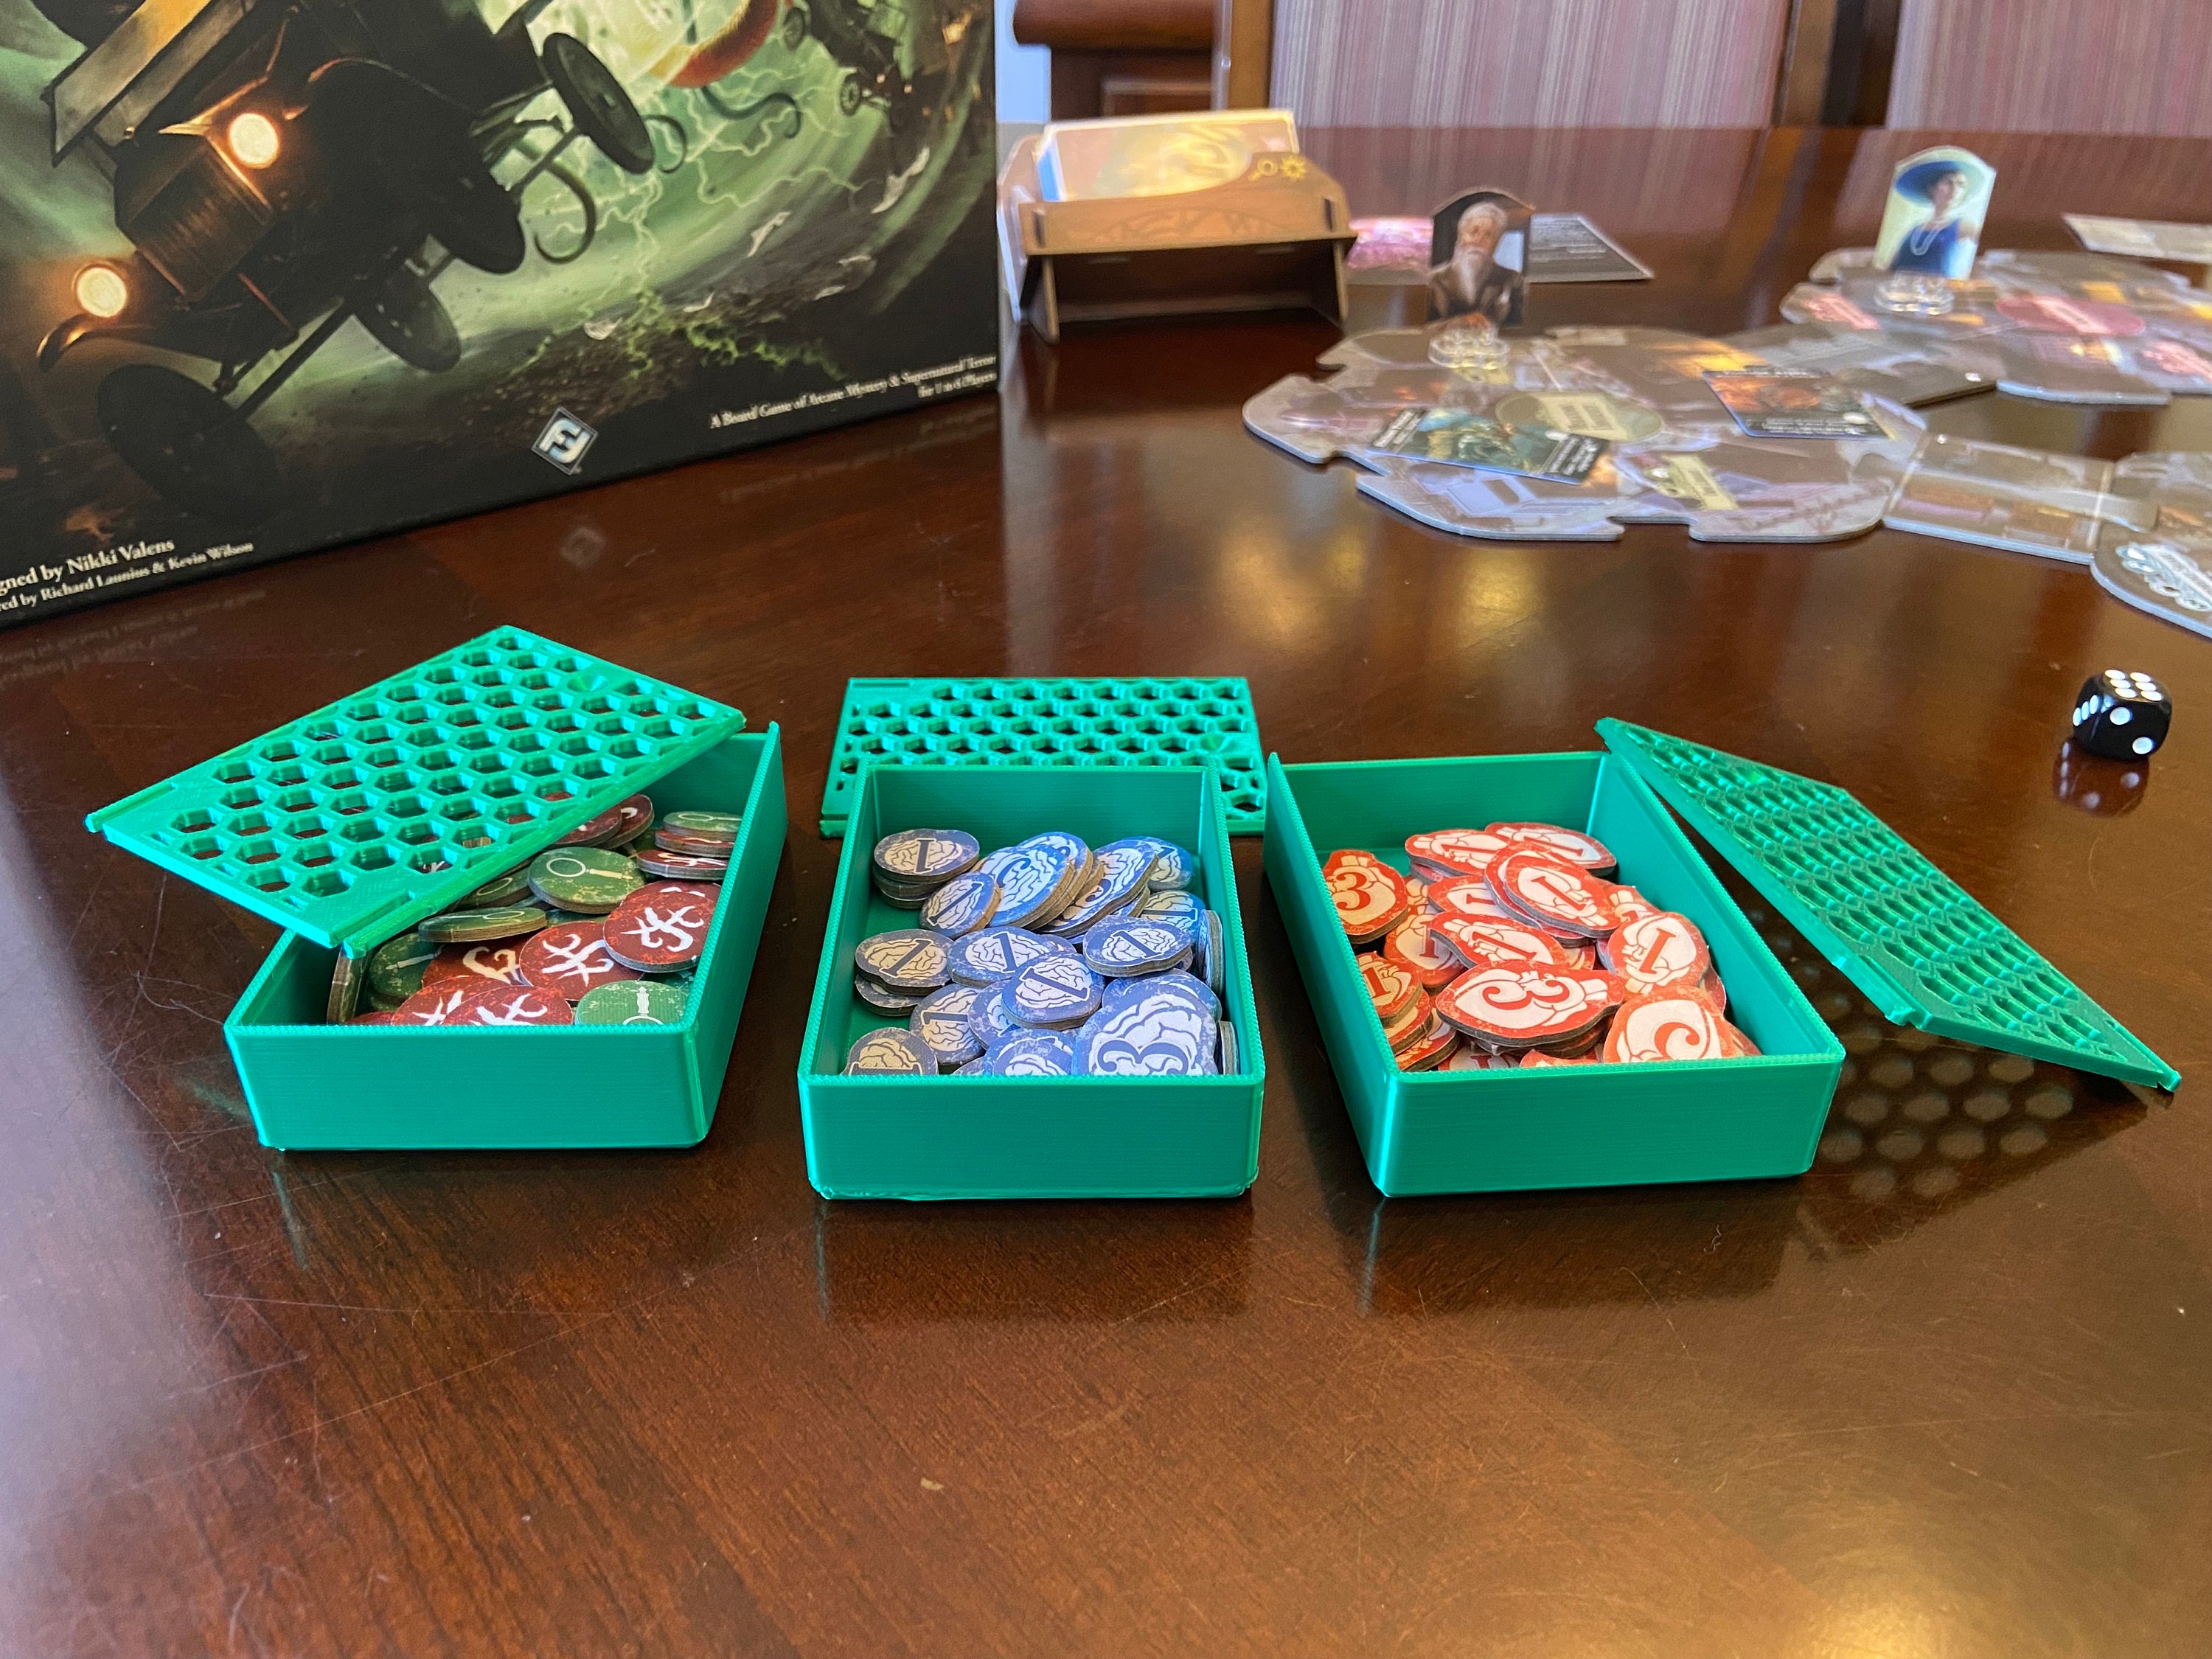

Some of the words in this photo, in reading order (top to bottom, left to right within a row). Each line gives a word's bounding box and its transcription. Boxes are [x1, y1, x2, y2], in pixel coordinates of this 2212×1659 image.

[710, 414, 721, 428] A
[721, 405, 758, 426] Board
[759, 403, 792, 417] Game
[793, 394, 807, 409] of
[40, 564, 63, 582] by
[66, 549, 118, 574] Nikki
[118, 540, 175, 561] Valens
[0, 594, 19, 611] ed
[20, 593, 37, 608] by
[41, 576, 94, 601] Richard
[152, 561, 165, 574] &
[168, 552, 207, 570] Kevin
[915, 838, 937, 874] 1
[1335, 871, 1371, 911] 3
[880, 938, 933, 978] 1
[992, 931, 1019, 973] 1
[1113, 930, 1163, 959] 1
[1639, 927, 1677, 975] 1
[1020, 966, 1090, 1001] 1
[1363, 966, 1392, 998] 1
